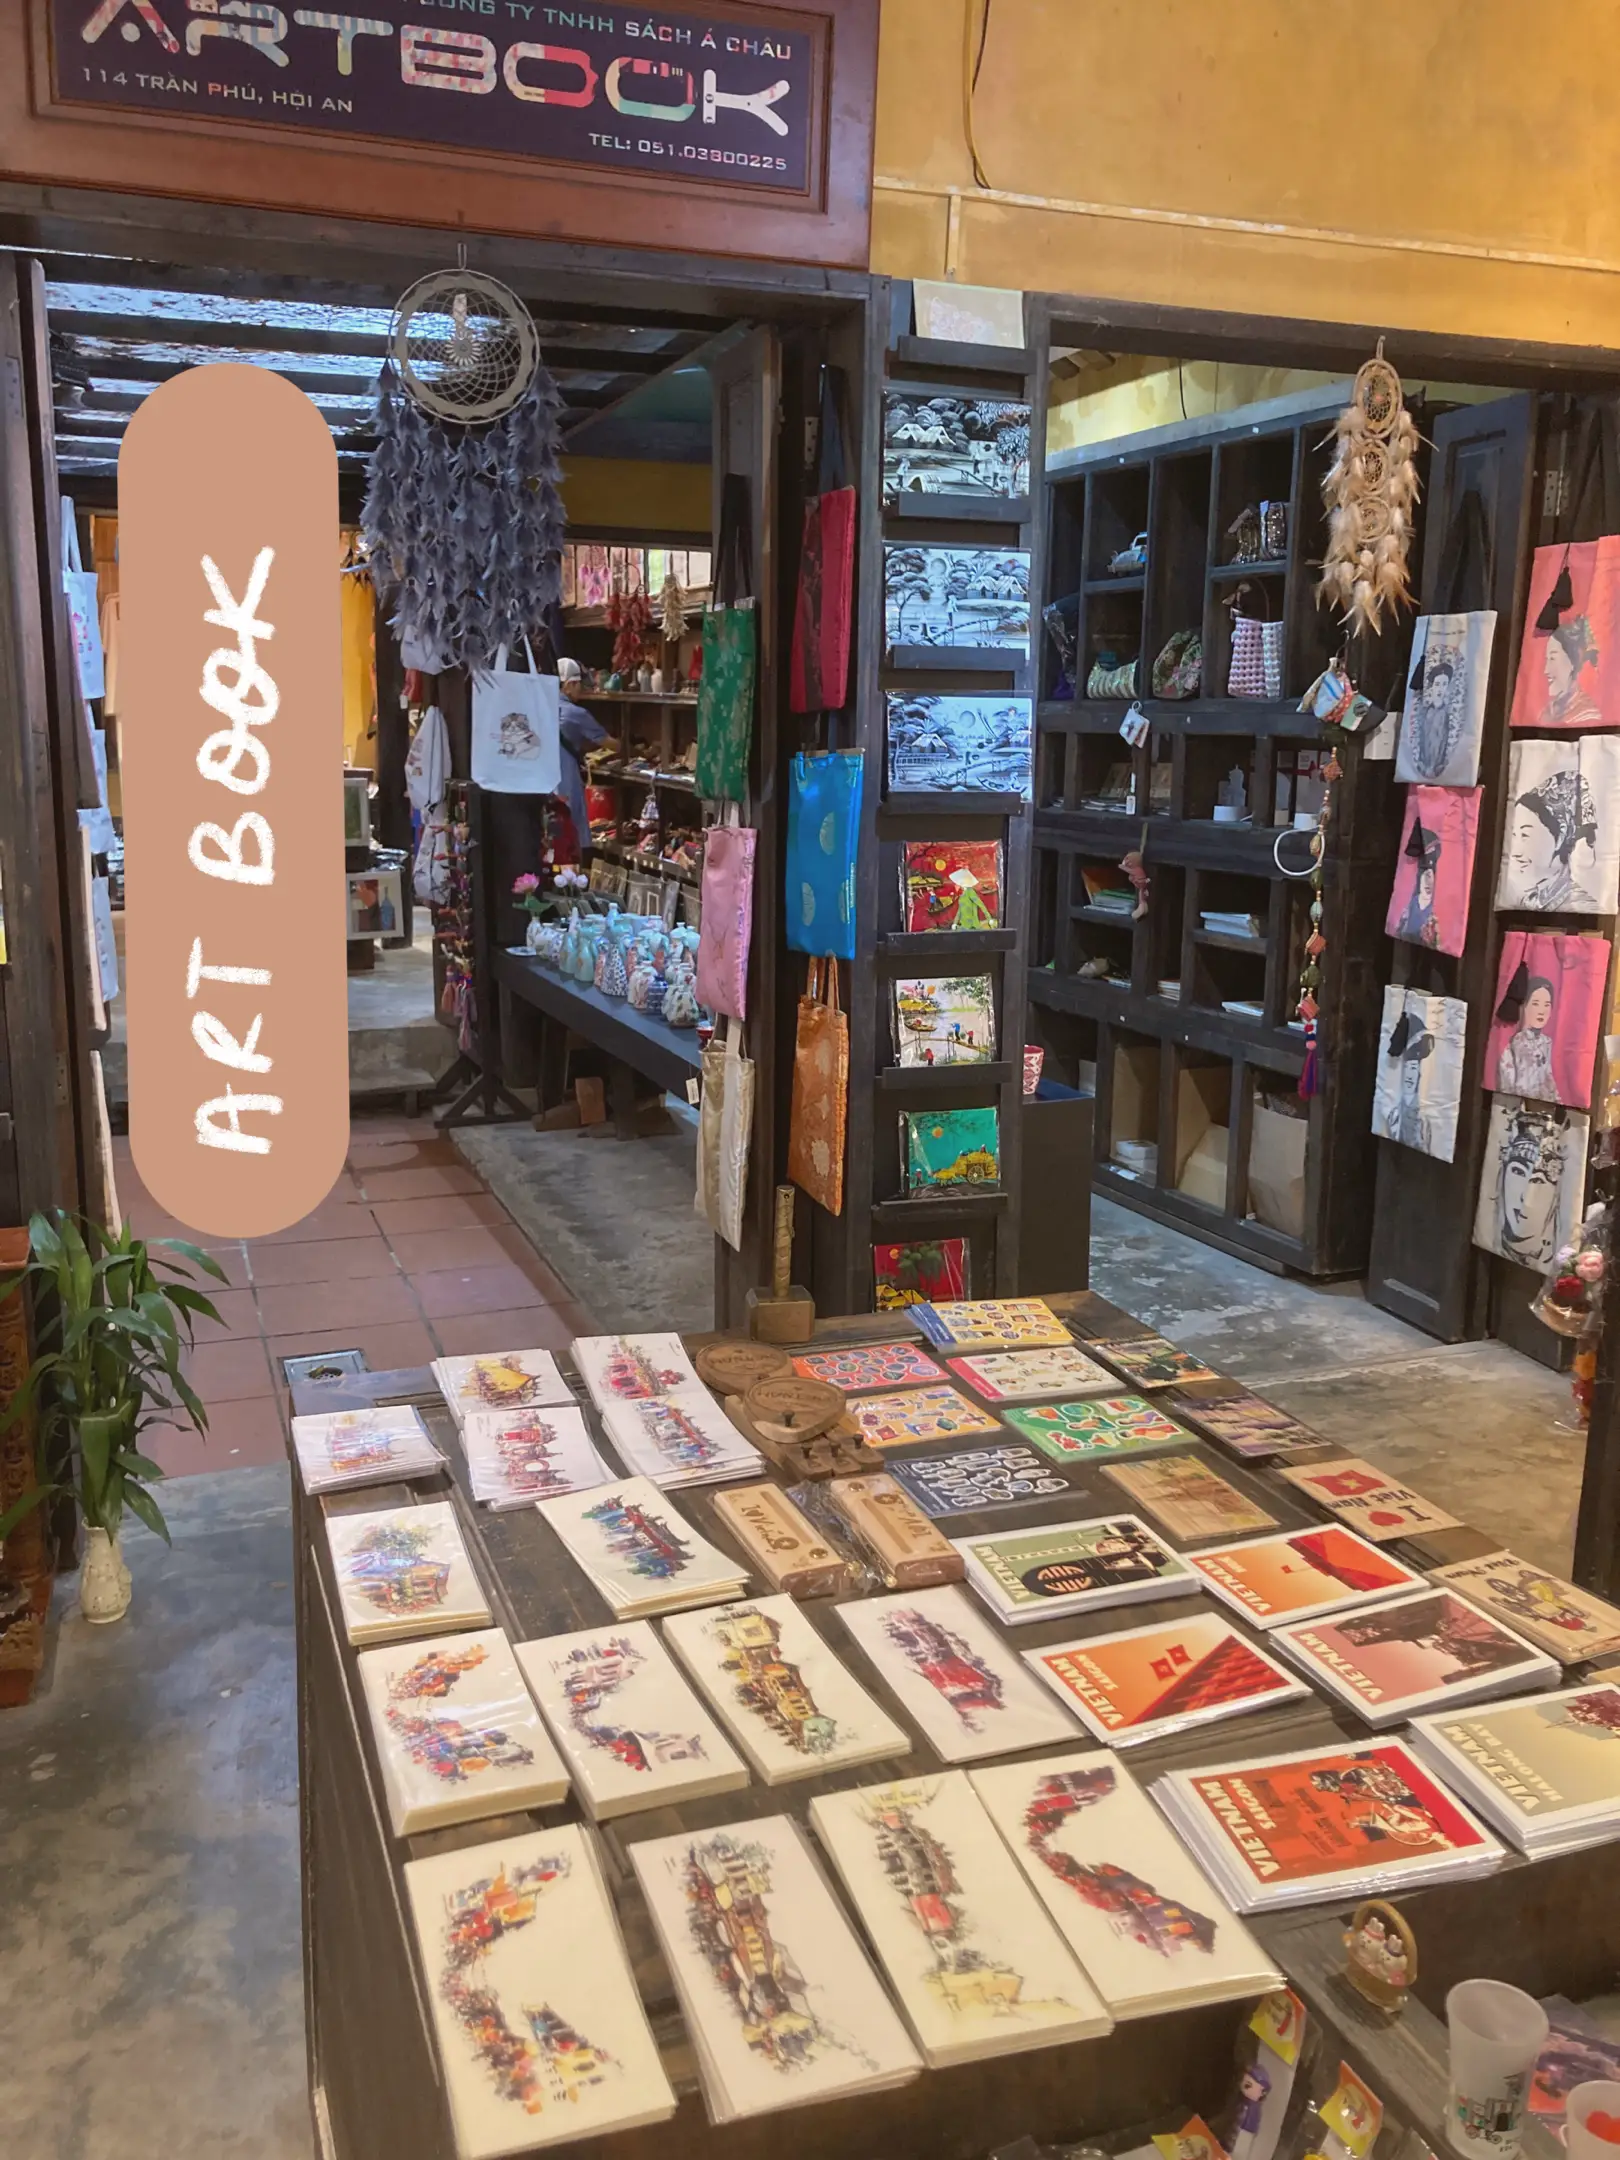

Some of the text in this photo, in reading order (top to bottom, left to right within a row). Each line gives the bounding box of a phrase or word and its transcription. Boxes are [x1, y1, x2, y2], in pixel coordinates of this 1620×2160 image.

[504, 2, 535, 21] TY
[543, 8, 615, 33] TNHH
[625, 18, 692, 45] SÁCH
[700, 27, 717, 50] Á
[726, 36, 791, 60] CHÂU
[82, 68, 128, 87] 114
[208, 82, 263, 105] PHÚ,
[321, 97, 353, 113] AN
[588, 132, 788, 171] TEL: 051.03800225
[975, 1544, 1031, 1600] VIETNAM
[1197, 1558, 1272, 1613] VIETNAM
[1050, 1656, 1125, 1727] VIETNAM
[1074, 1653, 1119, 1692] SAIGON
[1299, 1632, 1384, 1701] VIETNAM
[1442, 1725, 1541, 1811] VIETNAM
[1467, 1722, 1565, 1802] HALONG BAY
[1199, 1780, 1282, 1877] VIETNAM
[1227, 1777, 1278, 1830] SAIGON
